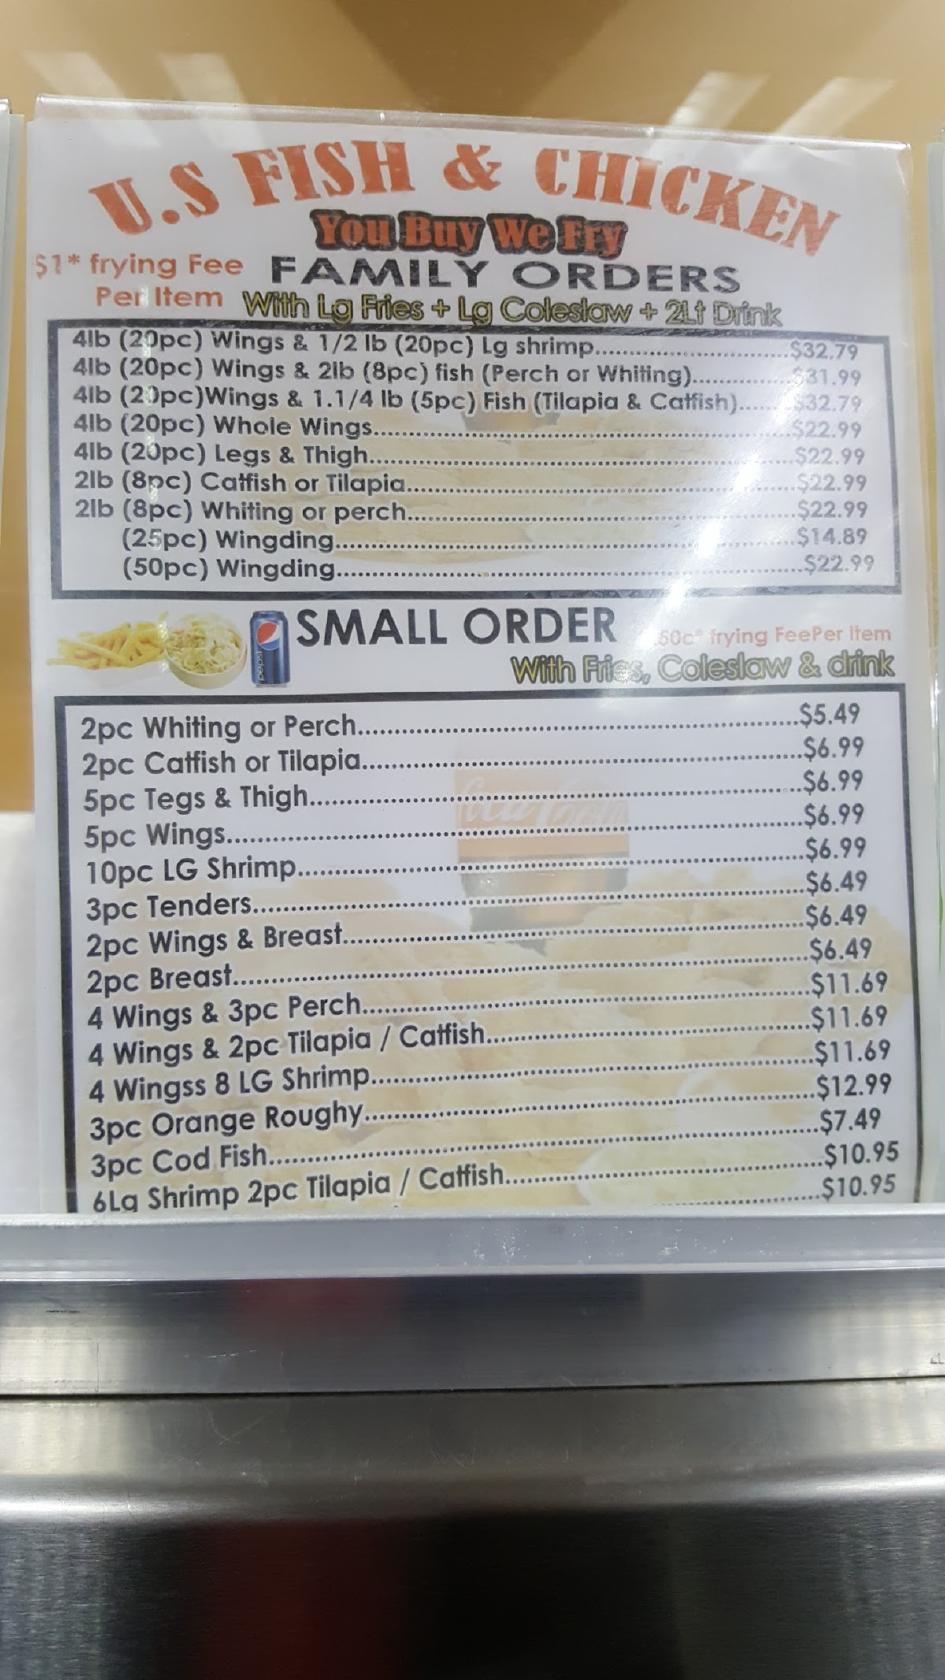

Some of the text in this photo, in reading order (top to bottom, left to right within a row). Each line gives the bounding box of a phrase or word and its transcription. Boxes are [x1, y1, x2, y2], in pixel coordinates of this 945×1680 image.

[88, 140, 841, 256] U.S FISH & CHICKEN
[310, 209, 629, 260] You Buy We Fry
[90, 253, 176, 279] frying
[189, 253, 244, 276] Fee
[271, 255, 740, 294] FAMILY ORDERS
[155, 286, 223, 307] Item
[242, 290, 783, 327] With Lg Fries Lg Coleslaw 2Lt Drink
[72, 329, 858, 361] 4lb (20pc) Wings 1/2 lb (20pc) Lg shrimp $32.79
[72, 357, 111, 376] 4lb
[120, 357, 203, 381] (20pc)
[212, 360, 285, 383] Wings
[318, 361, 355, 380] 2lb
[363, 361, 428, 385] (8pc)
[435, 362, 474, 382] fish
[482, 363, 558, 387] (Perch
[566, 369, 590, 382] or
[597, 365, 691, 388] Whiting)
[73, 385, 111, 404] 4lb
[313, 389, 373, 410] 1.1/4
[381, 389, 403, 408] lb
[411, 390, 475, 414] (5pc)
[484, 391, 525, 410] Fish
[534, 391, 618, 415] (Tilapia
[650, 392, 737, 416] Catfish)
[73, 413, 862, 440] 4lb (20pc) Whole Wings $22.99
[74, 441, 865, 468] 4lb (20pc) Legs Thigh $22.99
[75, 470, 867, 496] 2lb (8pc) Catfish or Tilapia $22.99
[75, 498, 868, 525] 2lb (8pc) Whiting or perch $22.99
[122, 526, 868, 554] (25pc) Wingding $14.89
[123, 554, 874, 582] (50pc) Wingding $22.99
[296, 607, 618, 647] SMALL ORDER
[711, 628, 768, 647] frying
[850, 625, 891, 641] Item
[510, 655, 576, 684] With
[657, 651, 792, 682] Coleslaw
[827, 649, 896, 677] drink
[81, 703, 860, 745] 2pc Whiting or Perch $5.49
[82, 736, 864, 781] 2pc Catfish or Tilapia $6.99
[83, 769, 863, 817] 5pc Tegs Thigh $6.99
[84, 803, 864, 853] 5pc Wings $6.99
[87, 836, 867, 889] 10pc LG Shrimp $6.99
[86, 870, 868, 926] 3pc Tenders $6.49
[86, 904, 867, 962] 2pc Wings Breast $6.49
[87, 938, 872, 999] 2pc Breast $6.49
[87, 971, 888, 1032] 4 Wings 3pc Perch $11.69
[88, 1005, 888, 1068] 4 Wings 2pc Tilapia Catfish $11.69
[89, 1038, 891, 1104] 4 Wingss 8 LG Shrimp $11.69
[90, 1072, 892, 1145] 3pc Orange Roughy $12.99
[91, 1107, 881, 1182] 3pc Cod Fish $7.49
[148, 1184, 239, 1211] Shrimp
[248, 1180, 298, 1208] 2pc
[306, 1174, 390, 1202] Tilapia
[419, 1162, 503, 1190] Catfish
[824, 1140, 899, 1171] $10.95
[821, 1173, 896, 1204] $10.95
